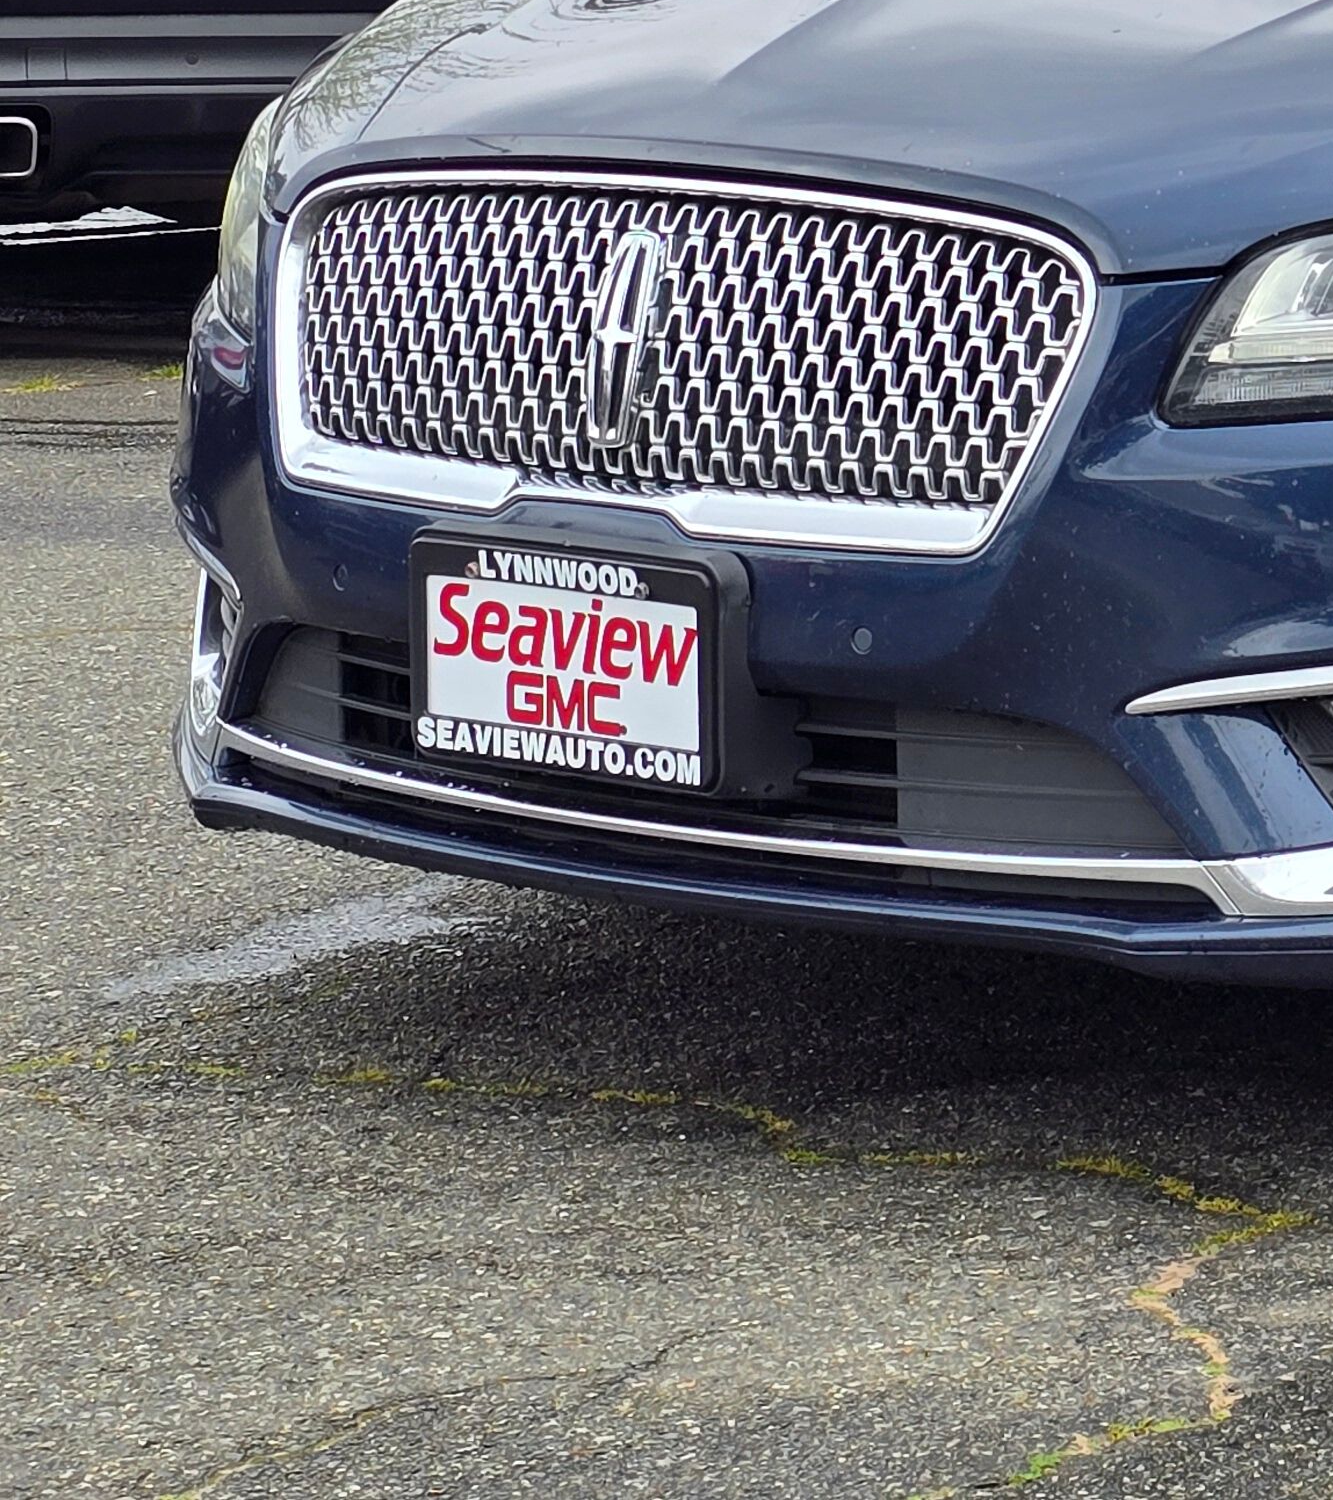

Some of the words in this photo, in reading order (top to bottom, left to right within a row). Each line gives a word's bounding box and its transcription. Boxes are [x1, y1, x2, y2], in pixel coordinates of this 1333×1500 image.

[477, 550, 638, 597] LYNNWOOD
[433, 582, 699, 687] Seaview
[506, 670, 622, 737] GMC
[416, 715, 701, 786] SEAVIEWAUTO.COM
